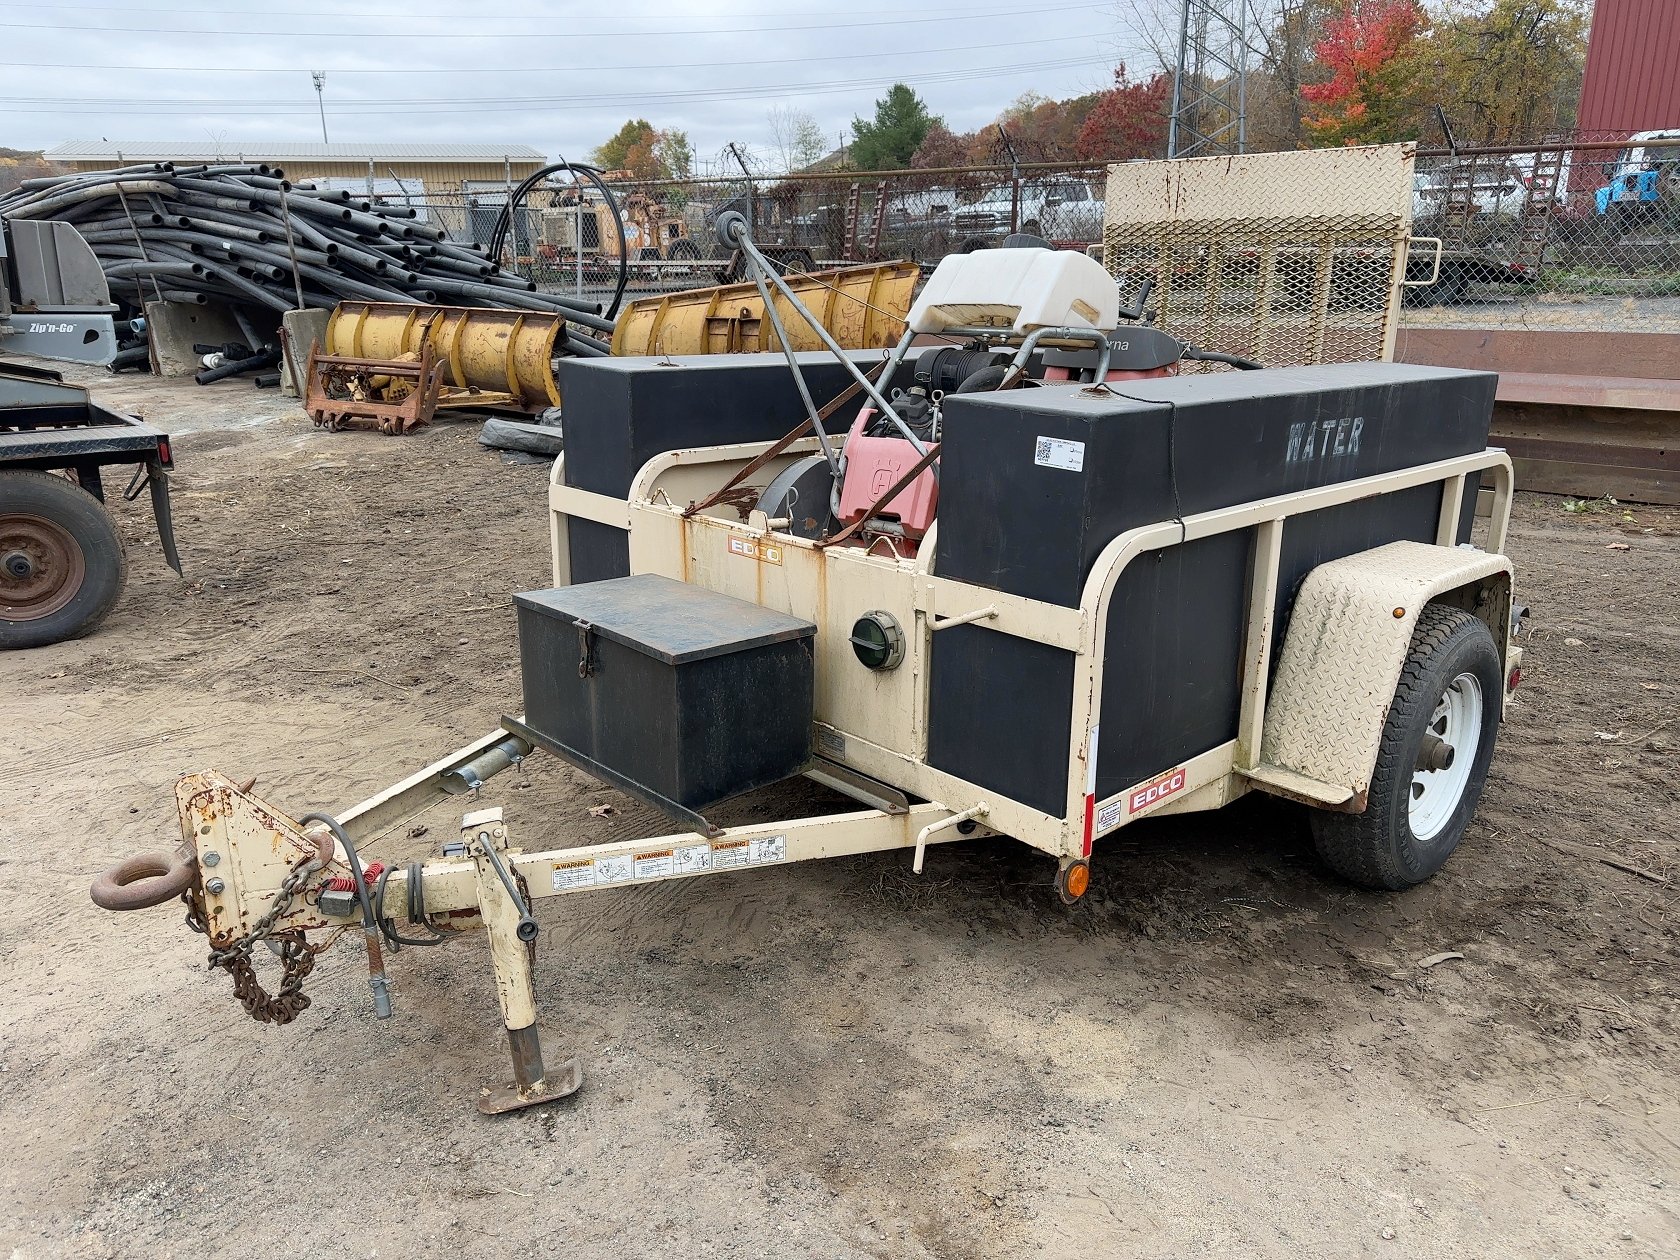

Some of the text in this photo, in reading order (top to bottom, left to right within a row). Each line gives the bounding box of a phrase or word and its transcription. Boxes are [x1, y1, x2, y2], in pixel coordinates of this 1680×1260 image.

[1286, 416, 1364, 462] WATER
[731, 539, 778, 561] EDCO
[1133, 774, 1182, 809] EDCO
[719, 841, 746, 850] WARNING
[641, 851, 670, 860] WARNING
[560, 861, 590, 870] WARNING
